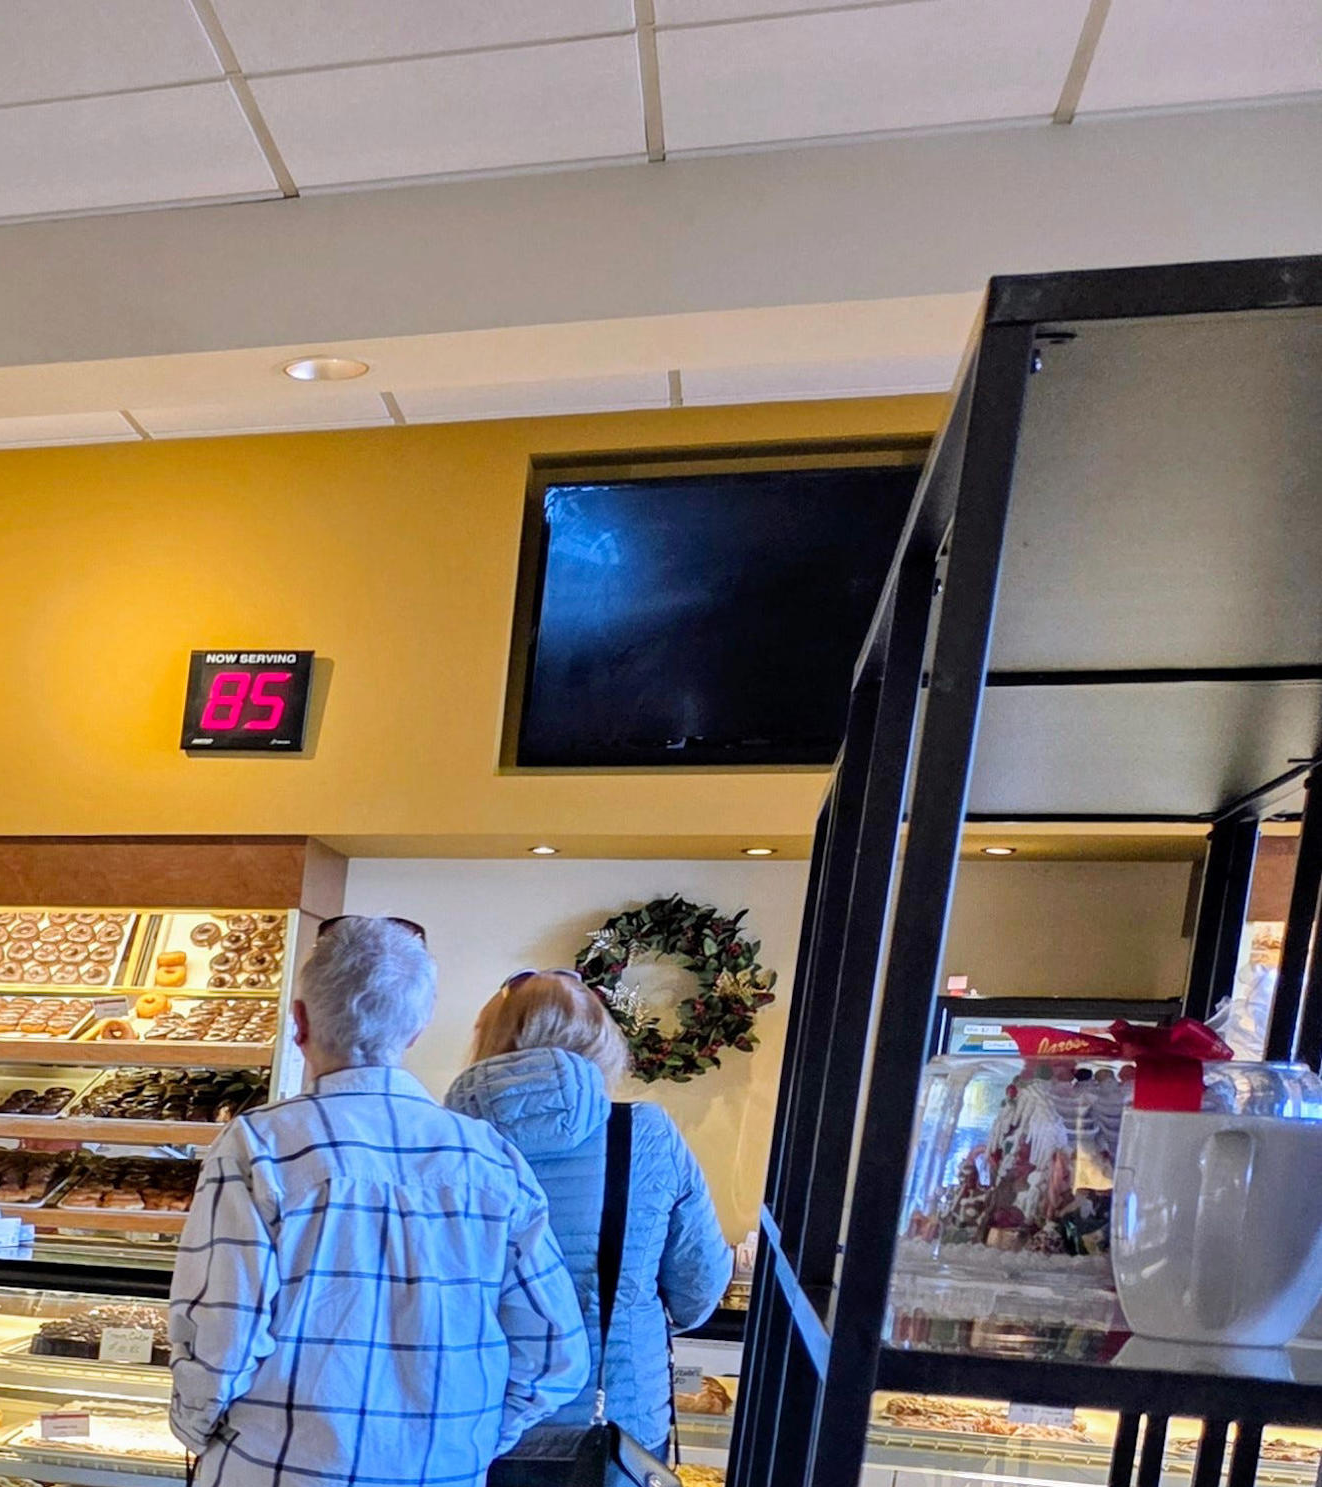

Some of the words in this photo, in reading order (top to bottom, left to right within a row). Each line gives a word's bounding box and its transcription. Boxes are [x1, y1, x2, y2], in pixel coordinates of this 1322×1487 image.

[205, 653, 238, 665] NOW
[239, 653, 297, 665] SERVING
[200, 671, 294, 731] 85
